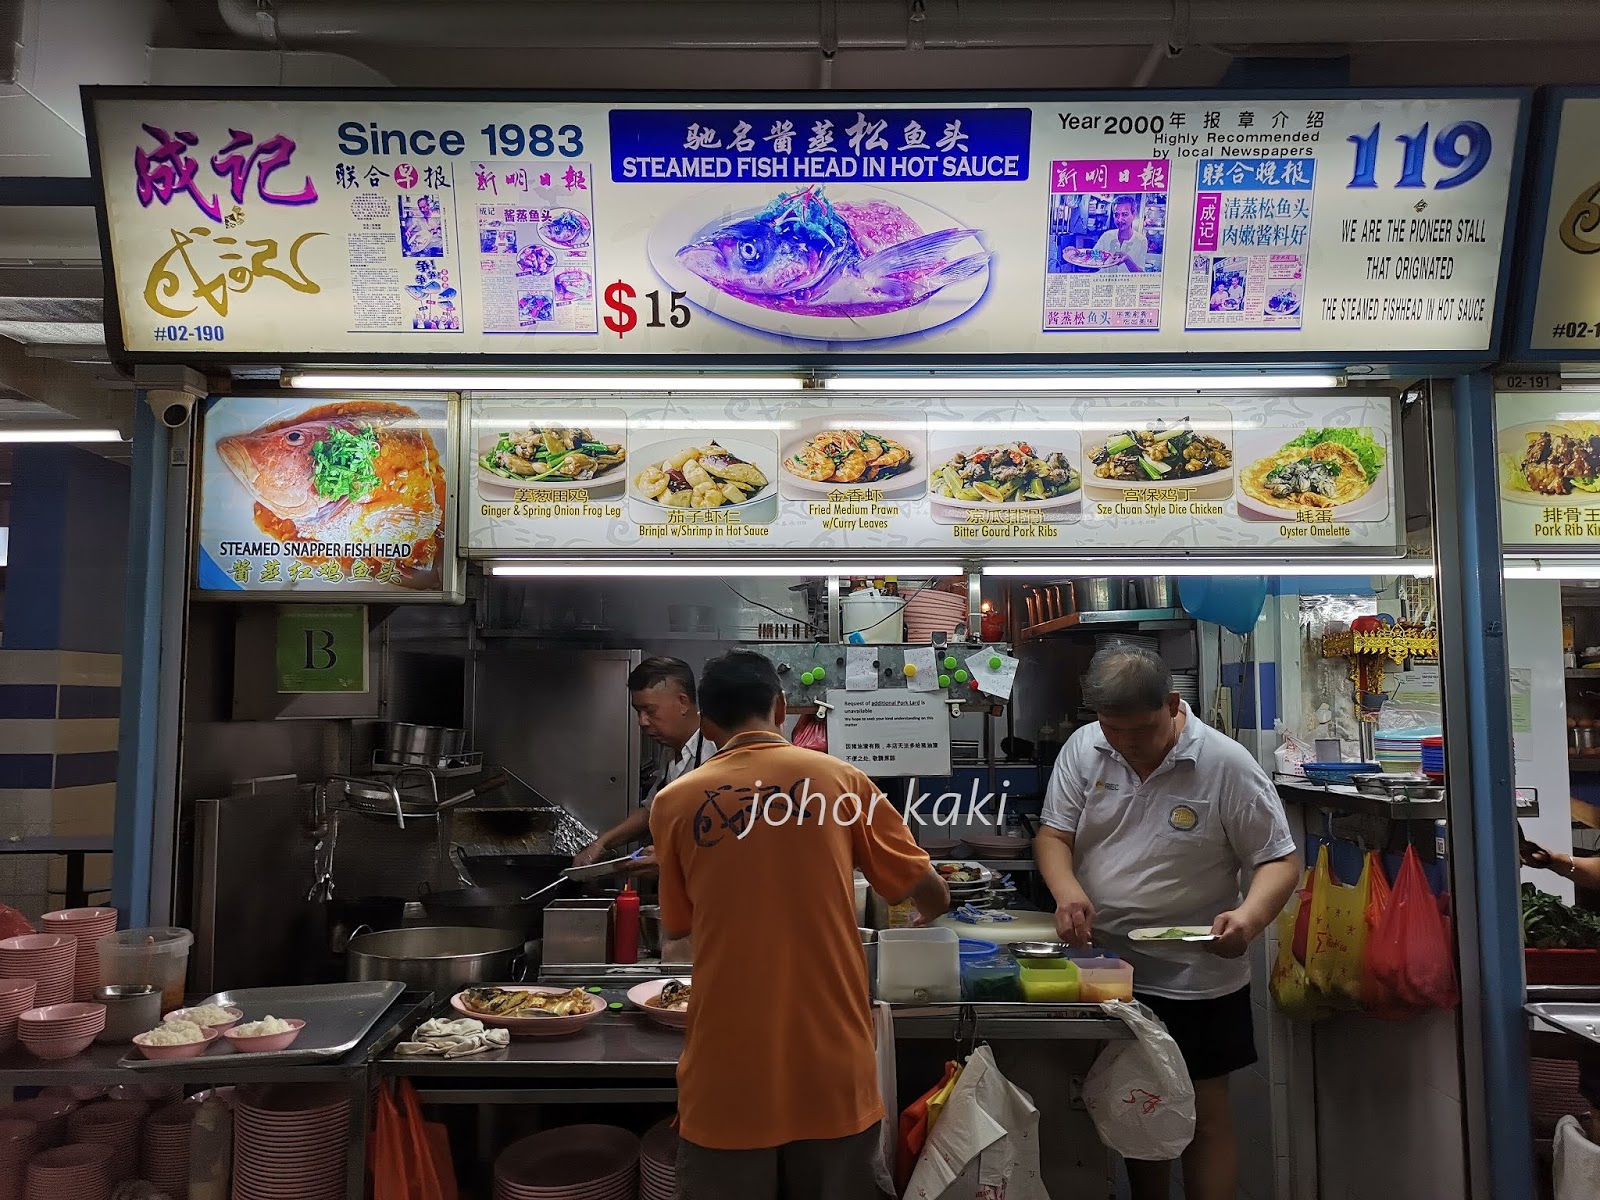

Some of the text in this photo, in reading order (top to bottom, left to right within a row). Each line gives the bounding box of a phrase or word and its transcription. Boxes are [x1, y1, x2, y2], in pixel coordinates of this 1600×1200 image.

[1058, 113, 1102, 130] Year
[1103, 115, 1165, 136] 2000
[337, 121, 585, 158] Since 1983
[682, 111, 970, 156] 驰名酱蒸松鱼头
[1153, 131, 1320, 147] Highly Recommended
[1153, 145, 1314, 160] by local Newspapers
[1345, 119, 1492, 190] 119
[134, 122, 319, 224] 成记
[622, 154, 1019, 179] STEAMED FISH HEAD IN HOT SAUCE
[1202, 159, 1311, 187] 联合晚报
[335, 161, 452, 190] 联合早报
[503, 208, 553, 223] 酱蒸鱼头
[1223, 197, 1310, 220] 清蒸松鱼头
[1221, 224, 1308, 247] 肉嫩酱料好
[1341, 218, 1487, 243] WE ARE THE PIONEER STALL
[1366, 256, 1454, 280] THAT ORIGINATED
[1047, 310, 1112, 326] 酱蒸松鱼头
[1321, 298, 1486, 322] THE STEAMED FISHHEAD IN HOT SAUCE
[153, 324, 226, 343] #02-190
[1552, 321, 1600, 338] #02-1
[513, 488, 589, 503] 姜葱田鸡
[827, 488, 884, 503] 金香虾
[1123, 487, 1198, 502] 宫保鸡丁
[480, 504, 621, 519] Ginger & Spring Onion Frog Leg
[667, 509, 741, 524] 茄子虾仁
[809, 503, 899, 515] Fried Medium Prawn
[1096, 503, 1223, 517] Sze Chuan Style Dice Chicken
[1295, 509, 1333, 524] 蚝蛋
[1543, 507, 1600, 523] 排骨王
[639, 525, 769, 538] Brinjal w/Shrimp in Hot Sauce
[822, 517, 888, 530] w/Curry Leaves
[953, 525, 1058, 537] Bitter Gourd Pork Ribs
[1279, 525, 1351, 538] Oyster Omelette
[1534, 523, 1562, 536] Pork
[1564, 523, 1583, 536] Rib
[219, 541, 412, 558] STEAMED SNAPPER FISH HEAD
[303, 629, 337, 670] B
